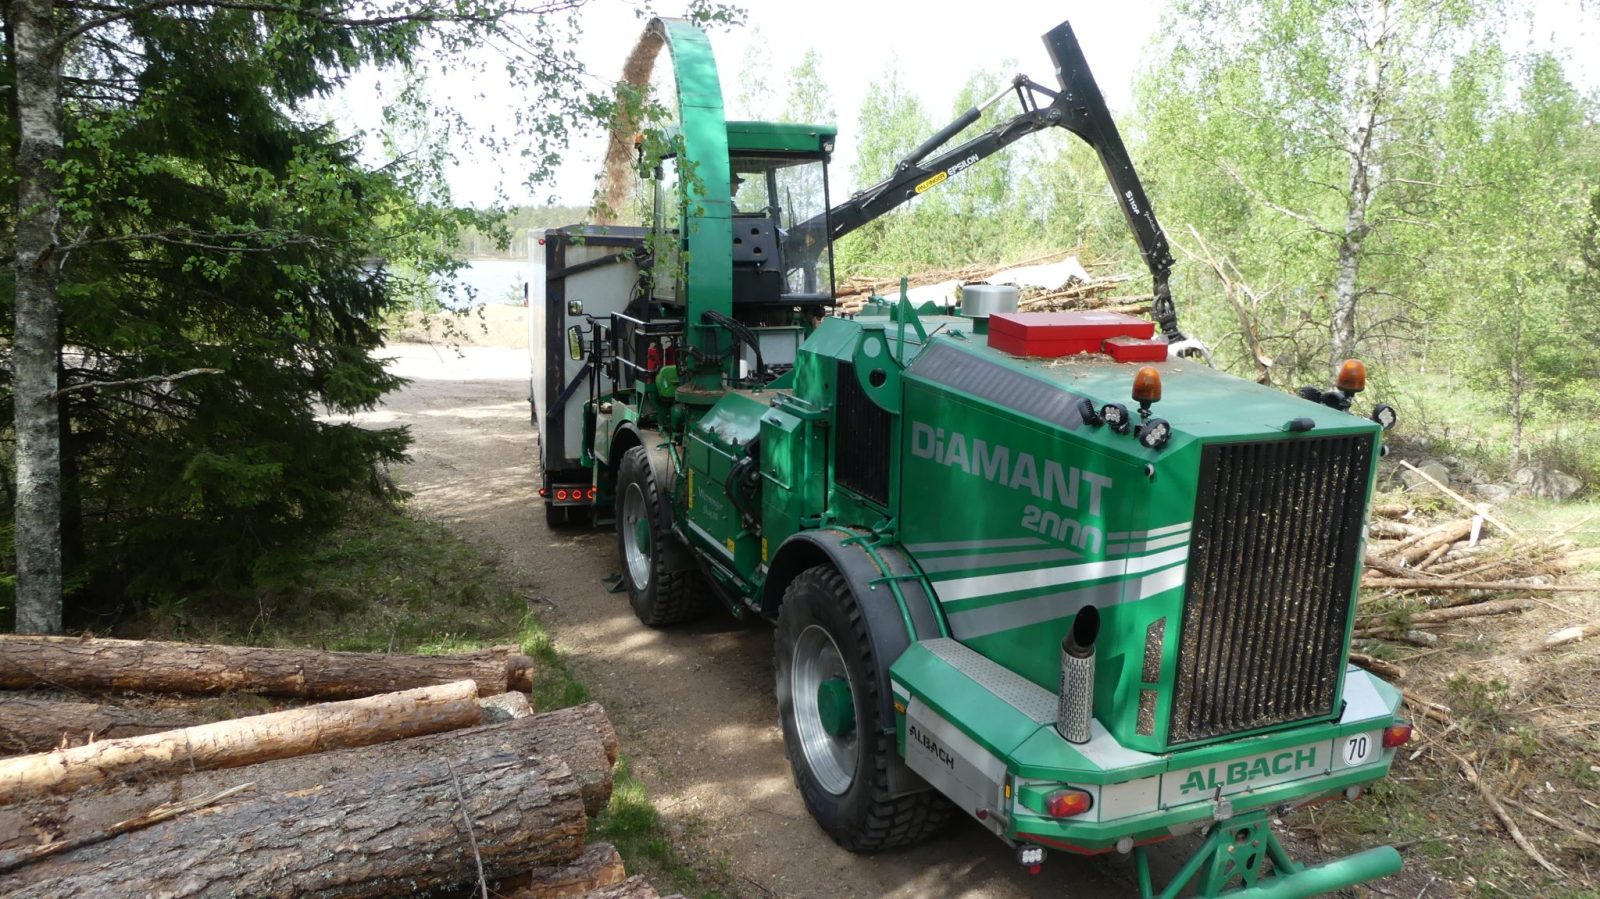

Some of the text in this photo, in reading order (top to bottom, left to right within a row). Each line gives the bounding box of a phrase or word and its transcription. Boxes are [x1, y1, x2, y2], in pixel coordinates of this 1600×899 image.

[947, 153, 979, 176] EPSILON
[1021, 504, 1103, 555] 2000
[909, 724, 954, 770] ALBACH
[1349, 736, 1367, 761] 70
[1179, 747, 1317, 795] ALBACH
